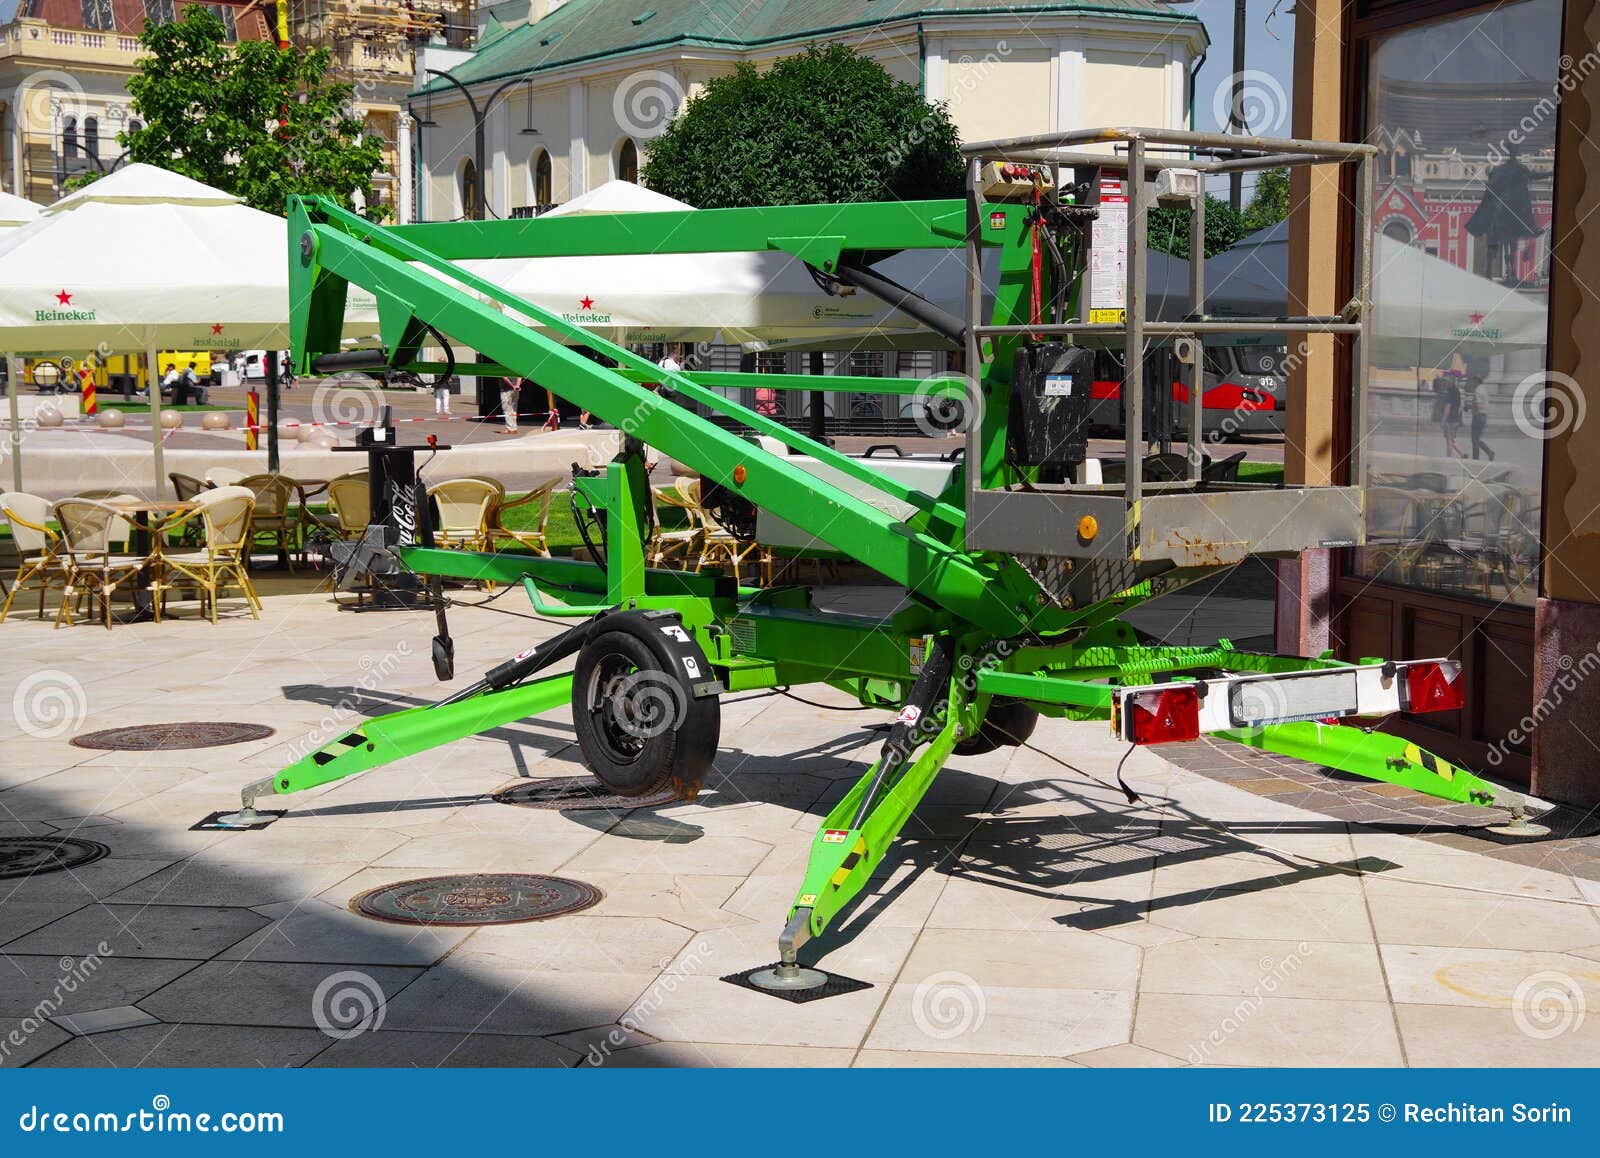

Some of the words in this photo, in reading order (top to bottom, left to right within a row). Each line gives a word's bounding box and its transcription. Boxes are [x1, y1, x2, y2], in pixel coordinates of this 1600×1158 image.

[35, 310, 96, 322] Heineken
[562, 313, 612, 323] Heineken
[1260, 378, 1273, 386] 312
[1233, 705, 1243, 717] RO
